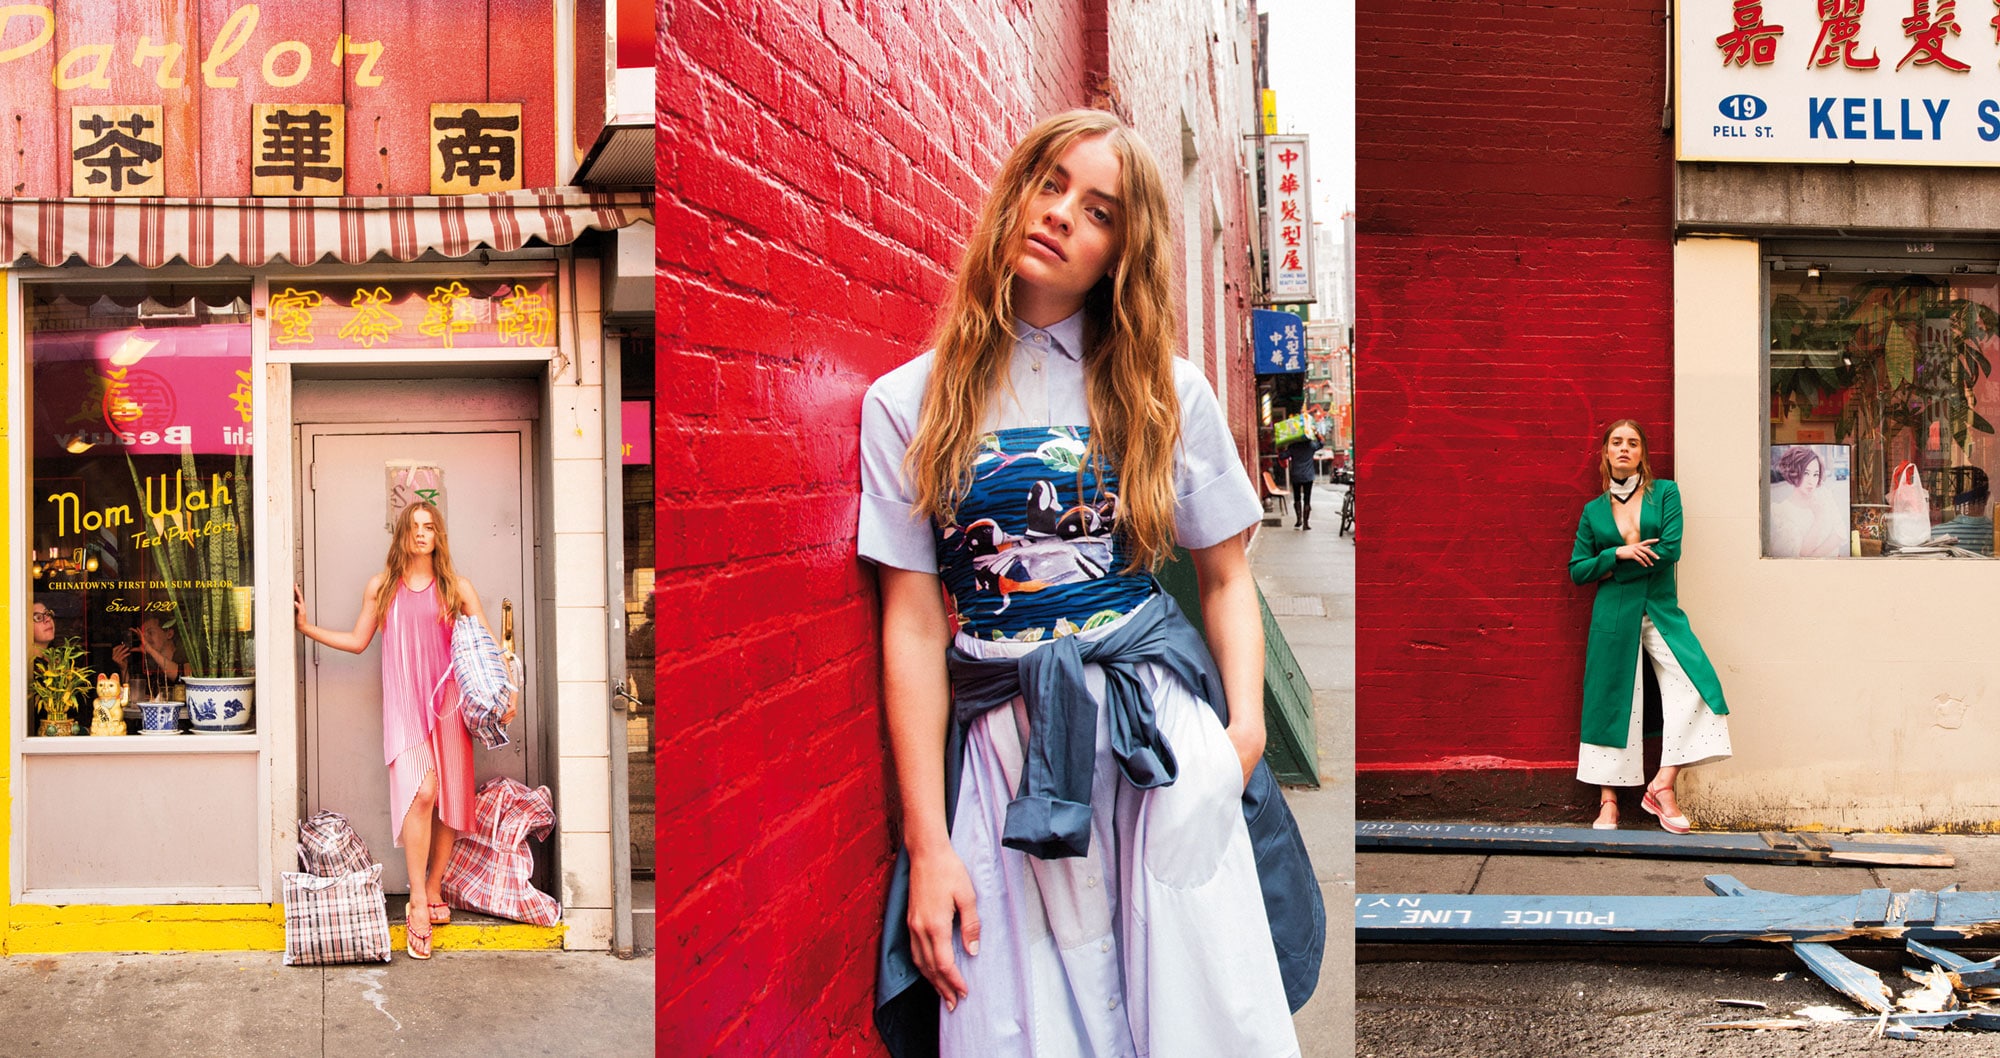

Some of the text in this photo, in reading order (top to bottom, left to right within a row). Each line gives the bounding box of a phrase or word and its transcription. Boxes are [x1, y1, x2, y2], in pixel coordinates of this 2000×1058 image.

[1716, 0, 2000, 73] 嘉麗髮
[0, 4, 385, 90] Parlor
[1729, 97, 1756, 118] 19
[1808, 97, 1950, 141] KELLY
[1713, 125, 1774, 139] PELL ST.
[48, 491, 134, 537] Nom
[168, 520, 233, 543] Parlor
[48, 579, 233, 590] CHINATOWN'S FIRST DIM SUM PARLOR
[105, 598, 178, 613] Since 1920
[1361, 822, 1555, 835] DO NOT CROSS
[1356, 897, 1421, 908] NY
[1399, 909, 1472, 924] LINE
[1501, 910, 1615, 925] POLICE
